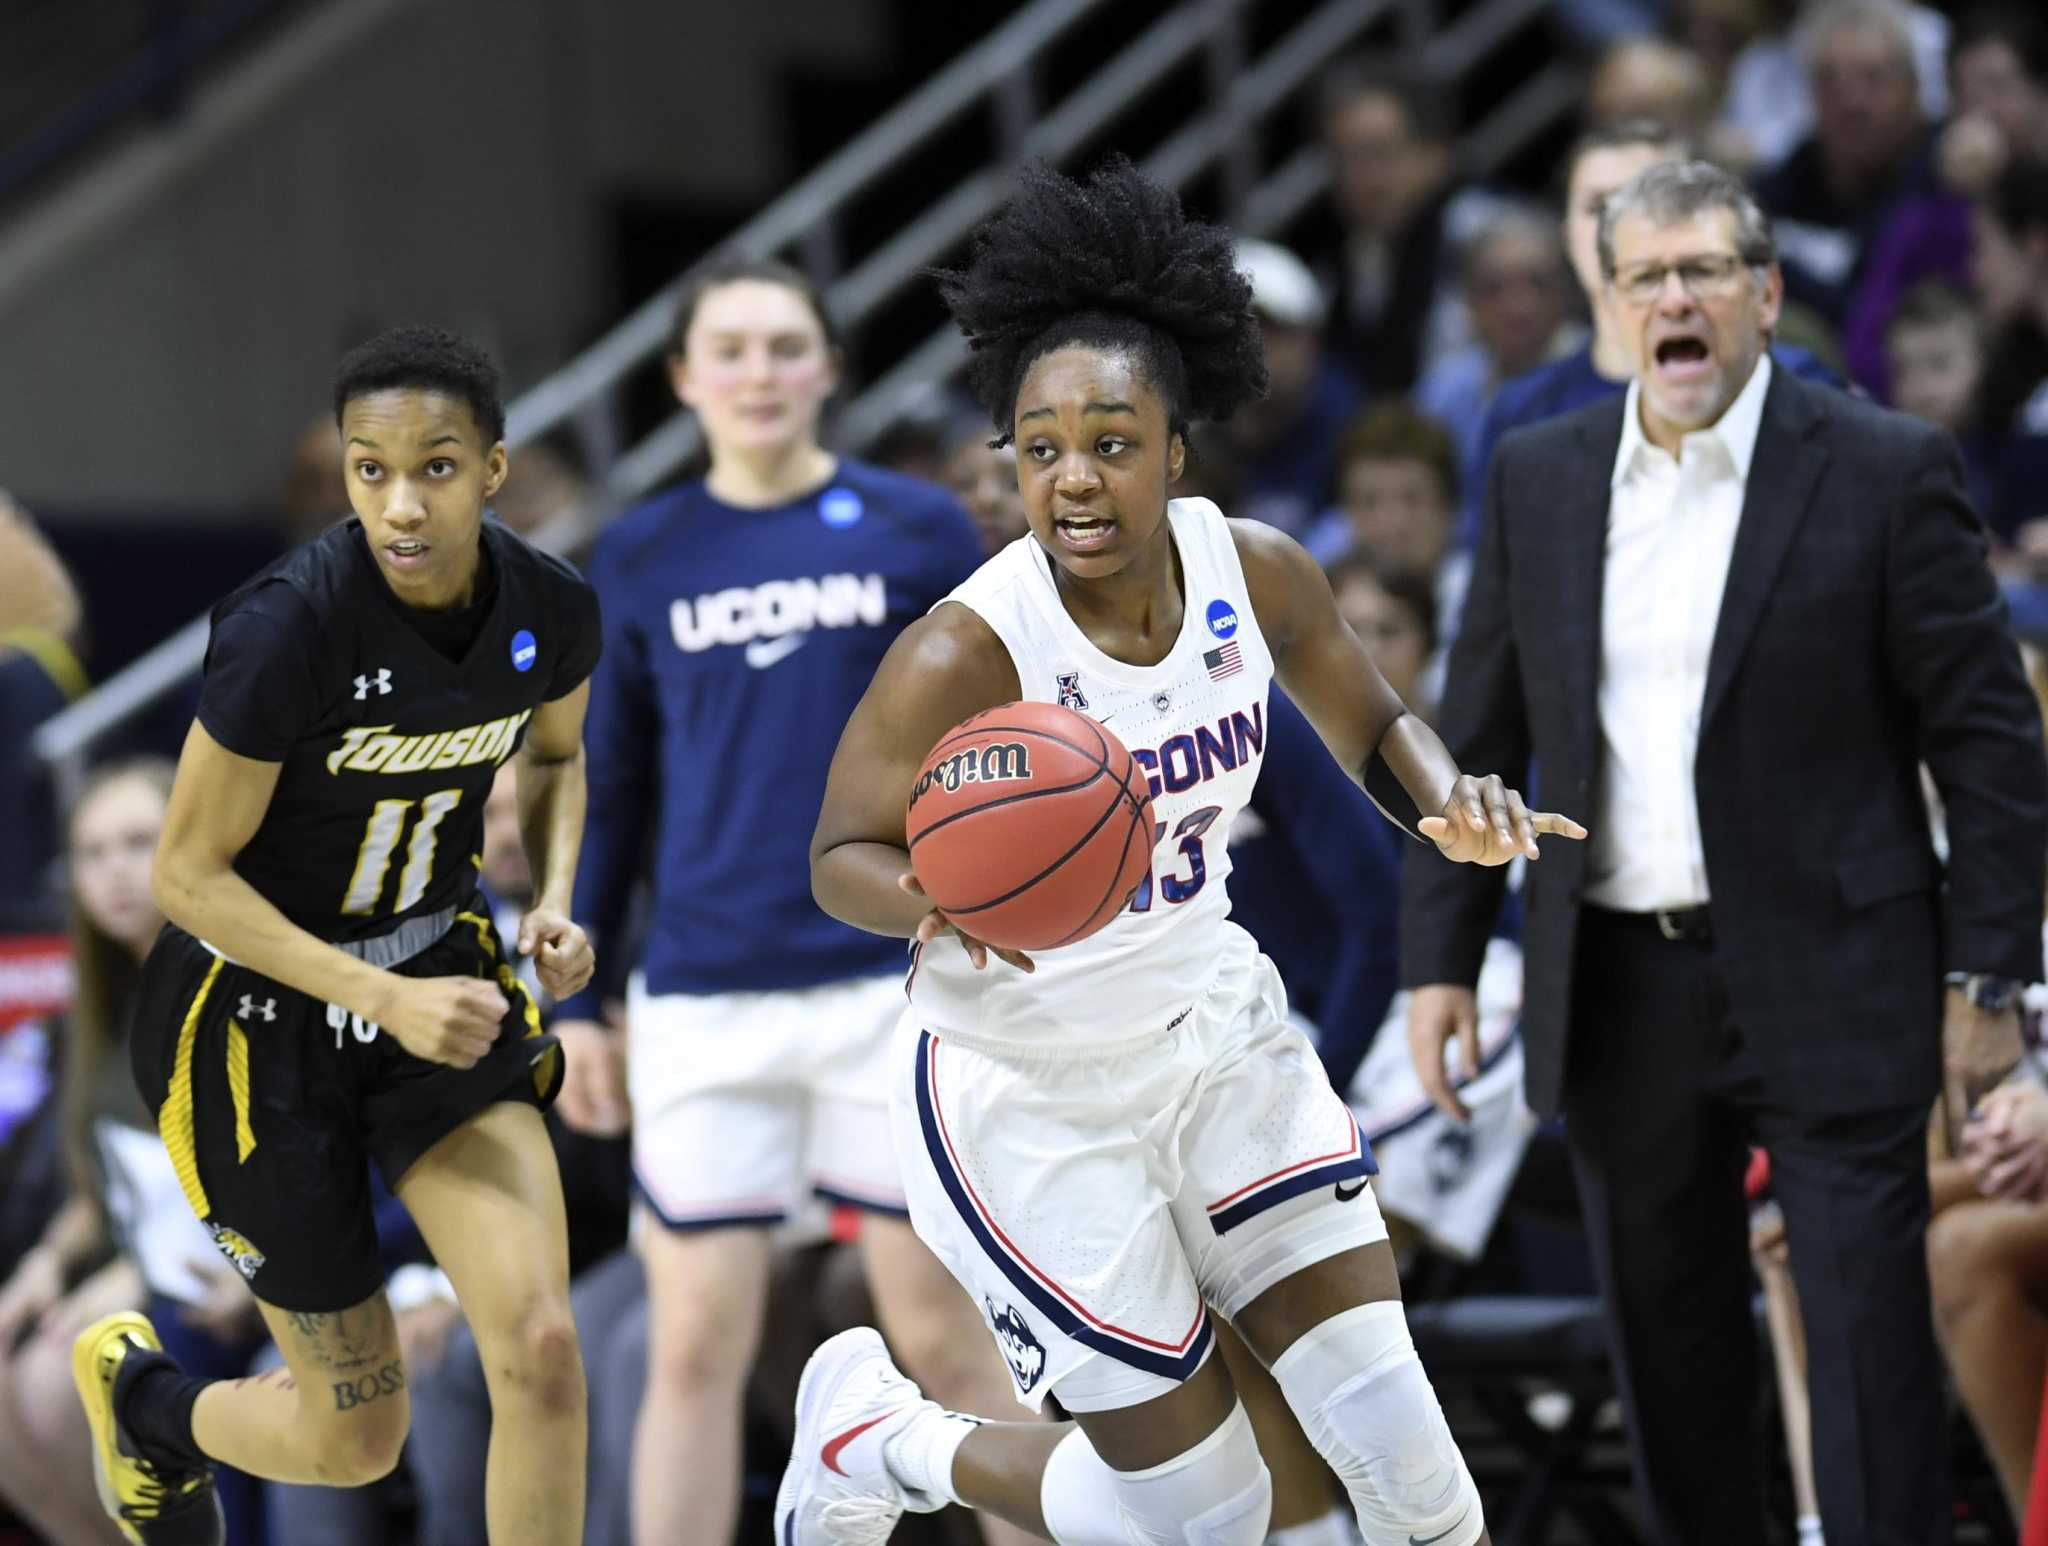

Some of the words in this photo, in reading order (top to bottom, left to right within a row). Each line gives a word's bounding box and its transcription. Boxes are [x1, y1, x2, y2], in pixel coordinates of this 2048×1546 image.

[669, 573, 886, 652] UCONN
[1212, 613, 1237, 632] NCAA
[908, 742, 1033, 813] Wilson
[1130, 701, 1263, 801] CONN
[341, 788, 463, 916] 11
